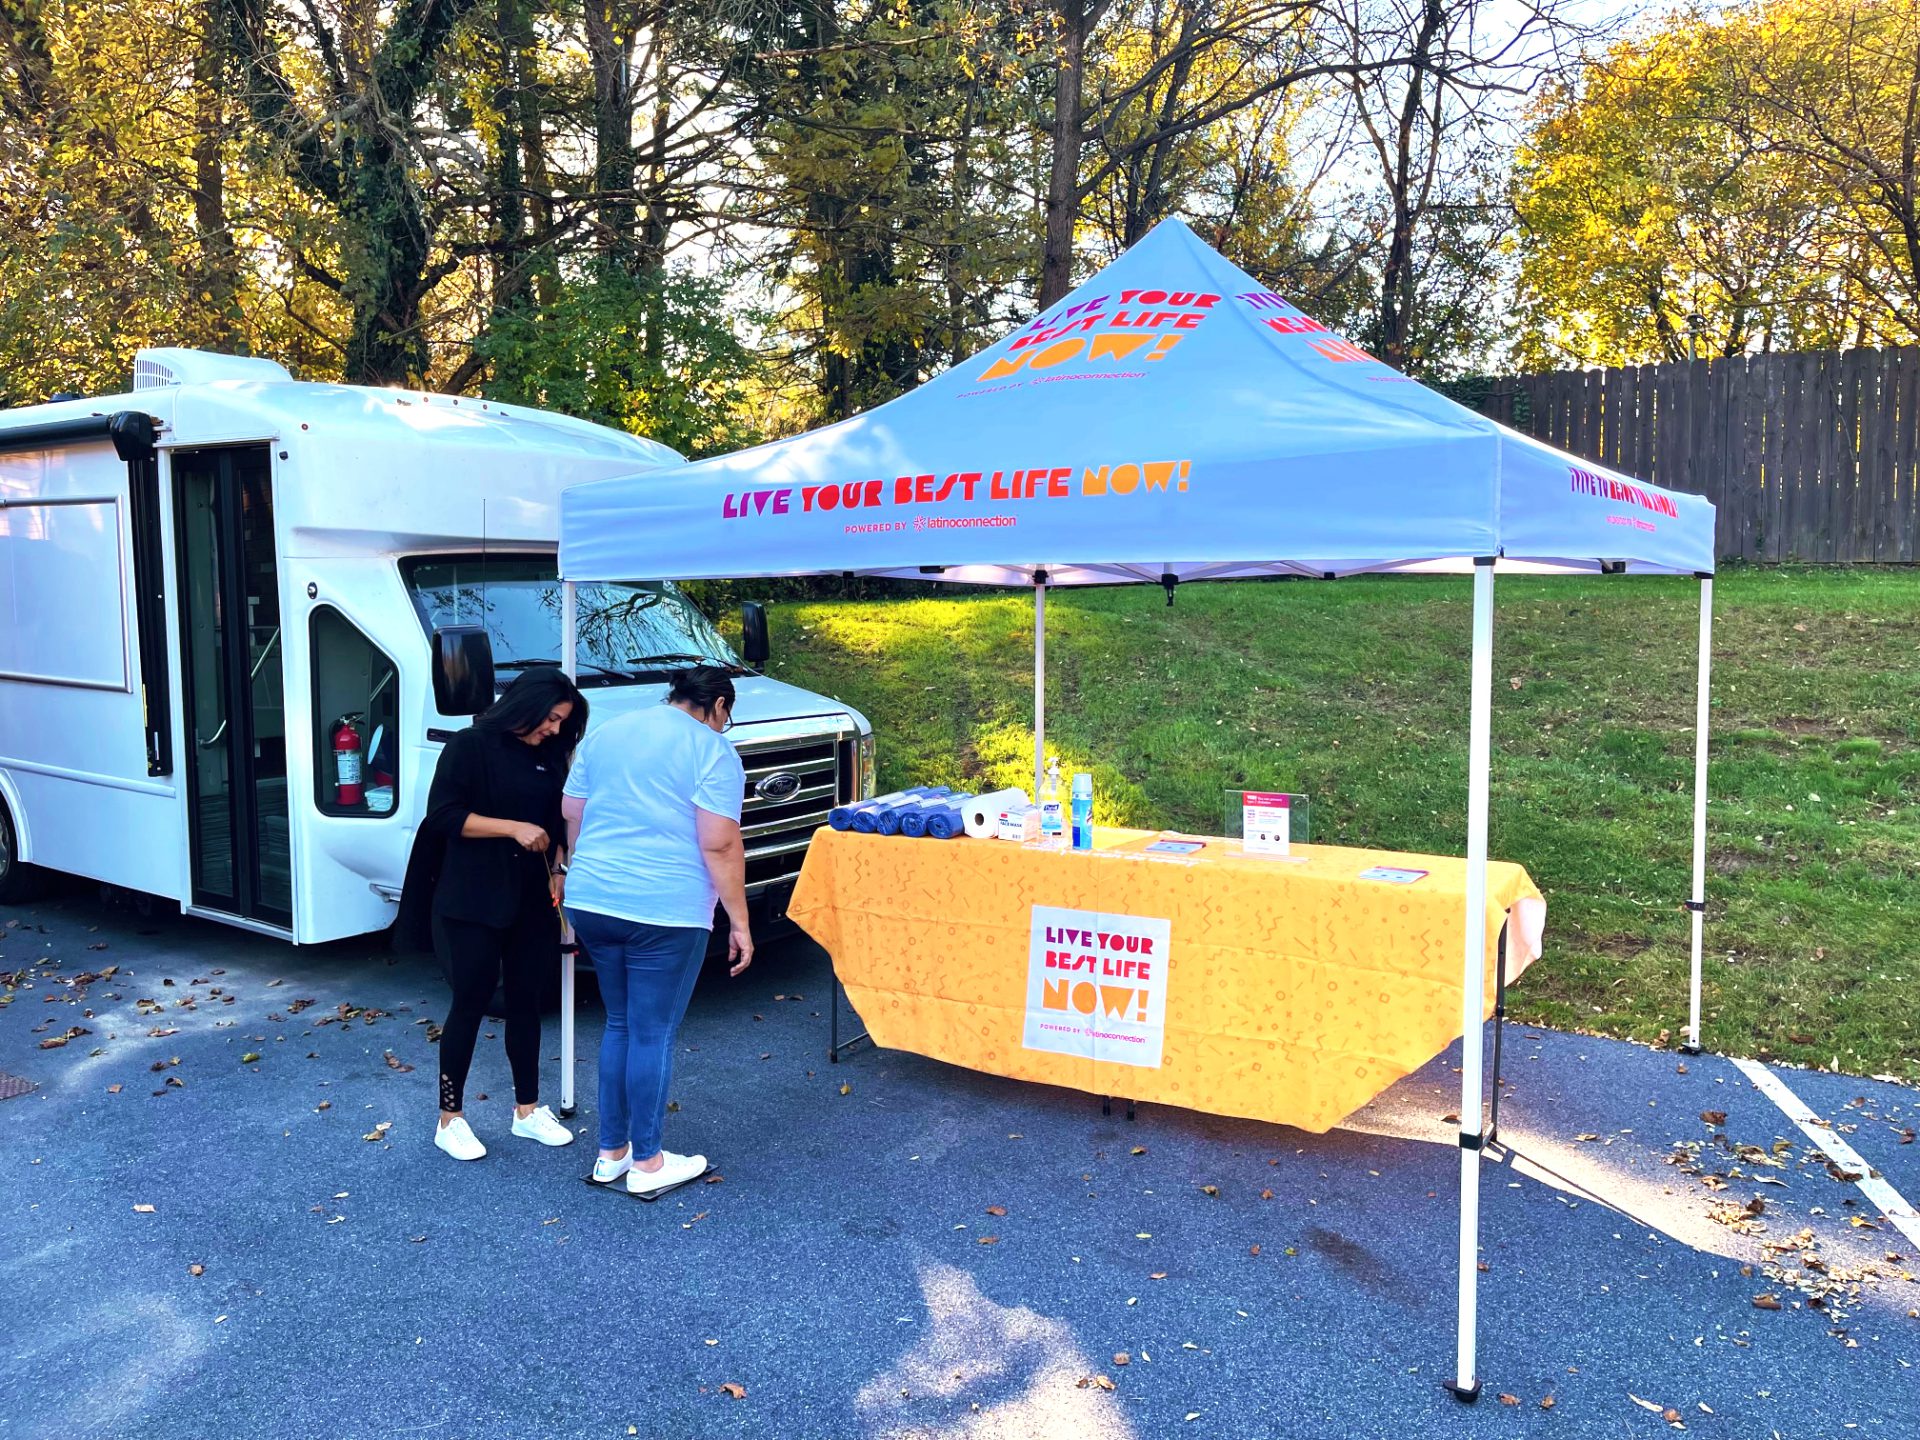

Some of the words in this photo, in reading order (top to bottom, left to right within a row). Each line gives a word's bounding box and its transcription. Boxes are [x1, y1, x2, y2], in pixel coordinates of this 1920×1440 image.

[1028, 295, 1111, 331] LIVE
[1119, 290, 1222, 308] YOUR
[1008, 313, 1107, 351] BEST
[1109, 311, 1206, 329] LIFE
[976, 334, 1185, 382] NOW!
[722, 488, 793, 519] LIVE
[801, 480, 883, 513] YOUR
[894, 472, 983, 504] BEST
[990, 467, 1072, 499] LIFE
[1081, 460, 1192, 497] NOW!
[845, 523, 892, 534] POWERED
[894, 521, 906, 531] BY
[927, 514, 1017, 529] latinoconnection
[1046, 927, 1092, 947] LIVE
[1097, 933, 1153, 955] YOUR
[1045, 950, 1097, 973] BEST
[1103, 958, 1150, 980] LIFE
[1042, 977, 1150, 1022] NOW!
[1040, 1023, 1071, 1033] POWERED
